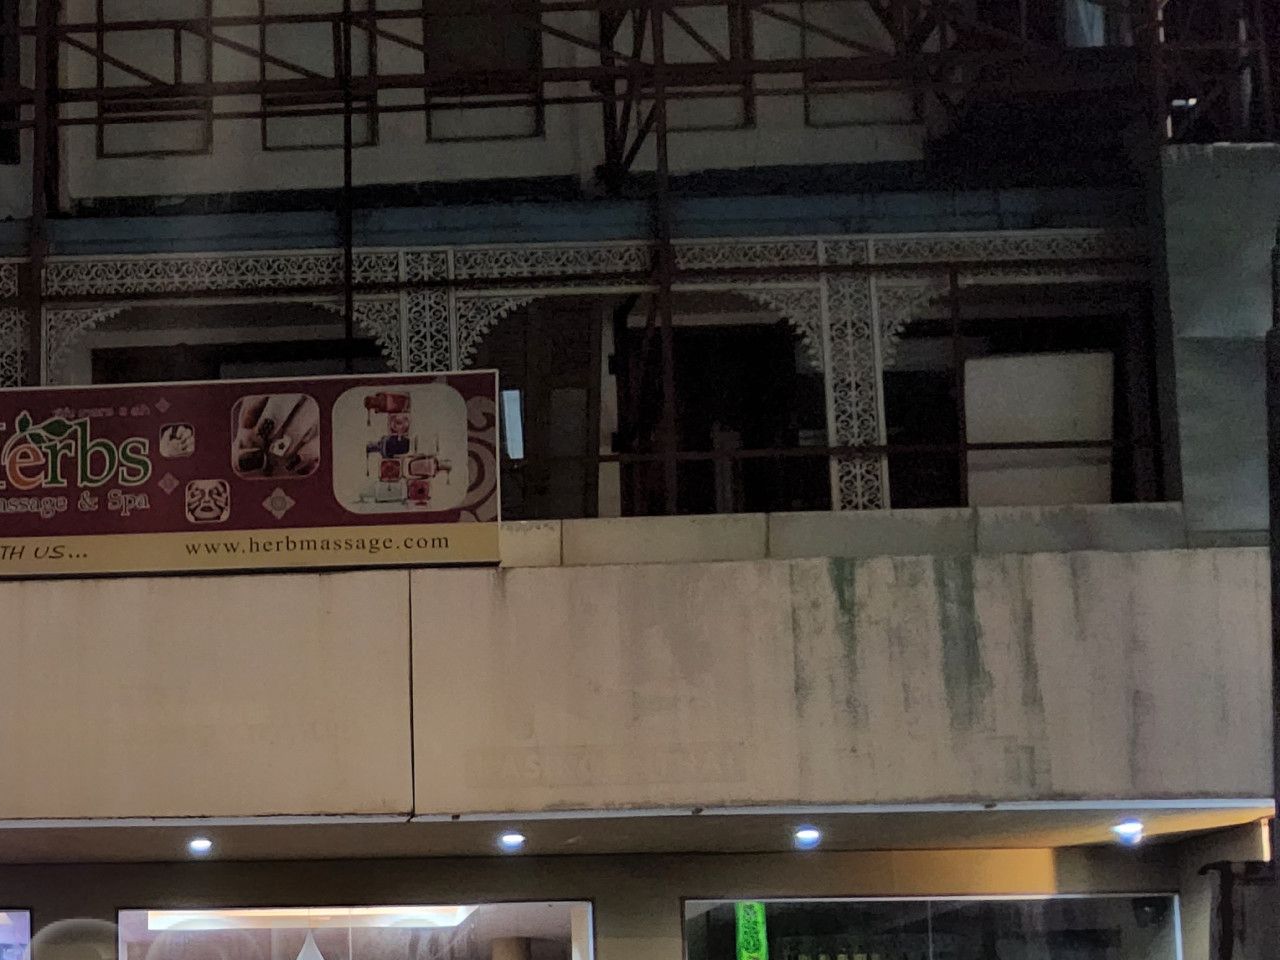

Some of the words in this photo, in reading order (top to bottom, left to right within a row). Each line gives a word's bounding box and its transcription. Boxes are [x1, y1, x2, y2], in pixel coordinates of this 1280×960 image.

[76, 490, 98, 511] &
[106, 488, 150, 517] Spa
[185, 535, 450, 556] www.herbmassage.com
